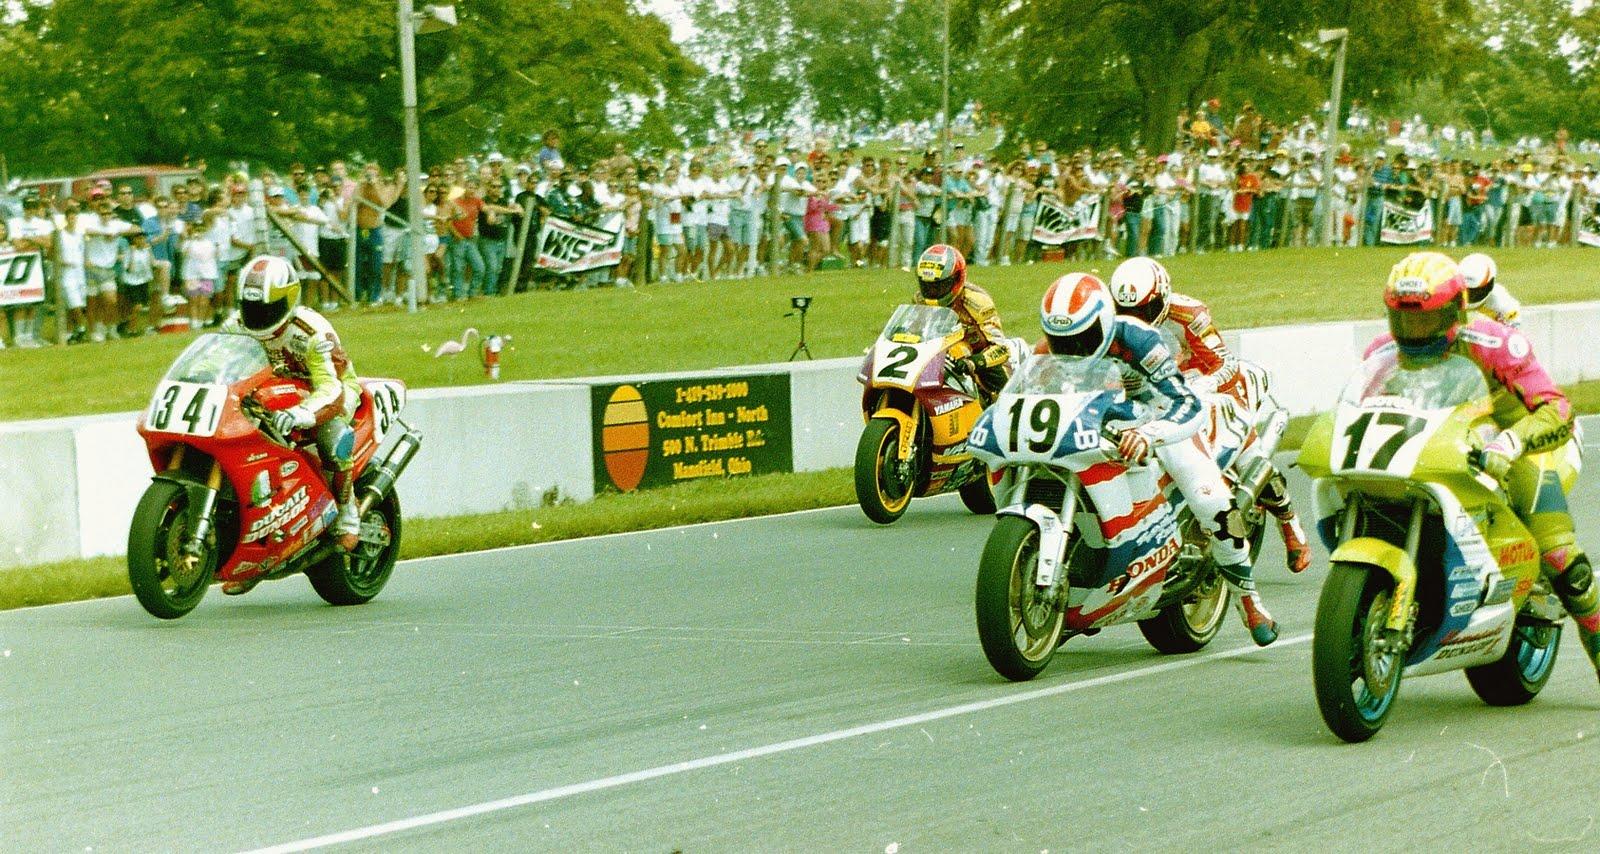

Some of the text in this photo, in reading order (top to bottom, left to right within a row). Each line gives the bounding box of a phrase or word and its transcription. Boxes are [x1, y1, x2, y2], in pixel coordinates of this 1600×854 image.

[1051, 315, 1070, 325] Arai
[877, 345, 919, 380] 2
[374, 384, 400, 434] 34
[657, 410, 703, 429] Comfort
[706, 408, 726, 426] Inn
[737, 404, 769, 424] North
[933, 397, 964, 416] YAMAHA
[1008, 398, 1061, 453] 19
[1343, 411, 1428, 470] 17
[728, 456, 752, 475] Ohio
[1106, 537, 1180, 596] HONDA
